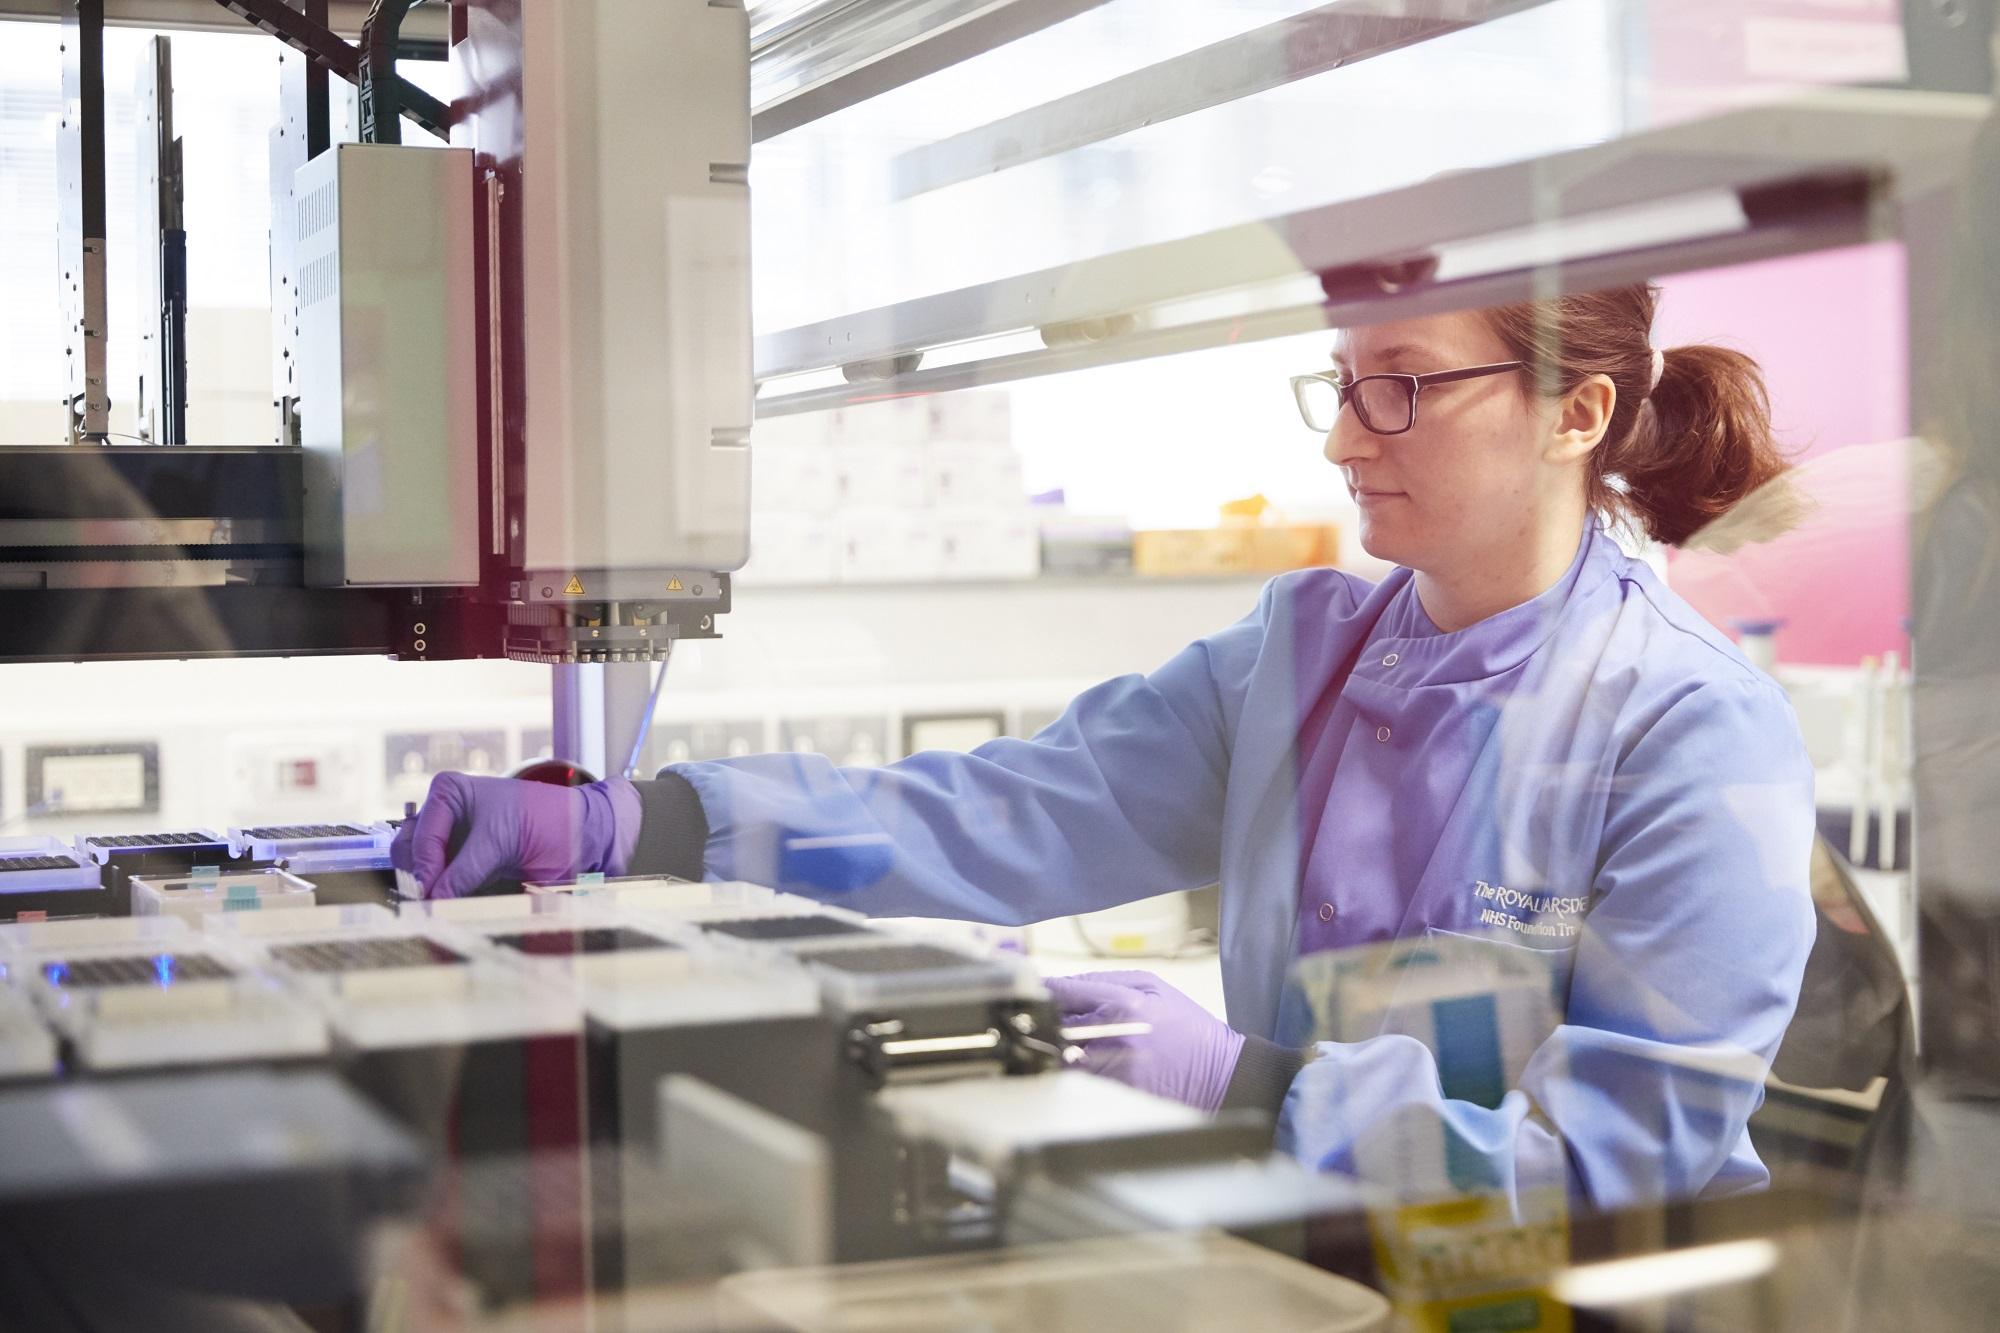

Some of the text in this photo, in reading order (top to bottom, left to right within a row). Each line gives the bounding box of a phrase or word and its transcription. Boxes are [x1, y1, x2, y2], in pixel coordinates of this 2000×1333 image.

[1474, 880, 1494, 899] The
[1496, 886, 1541, 913] ROYAL
[1480, 908, 1505, 926] NHS
